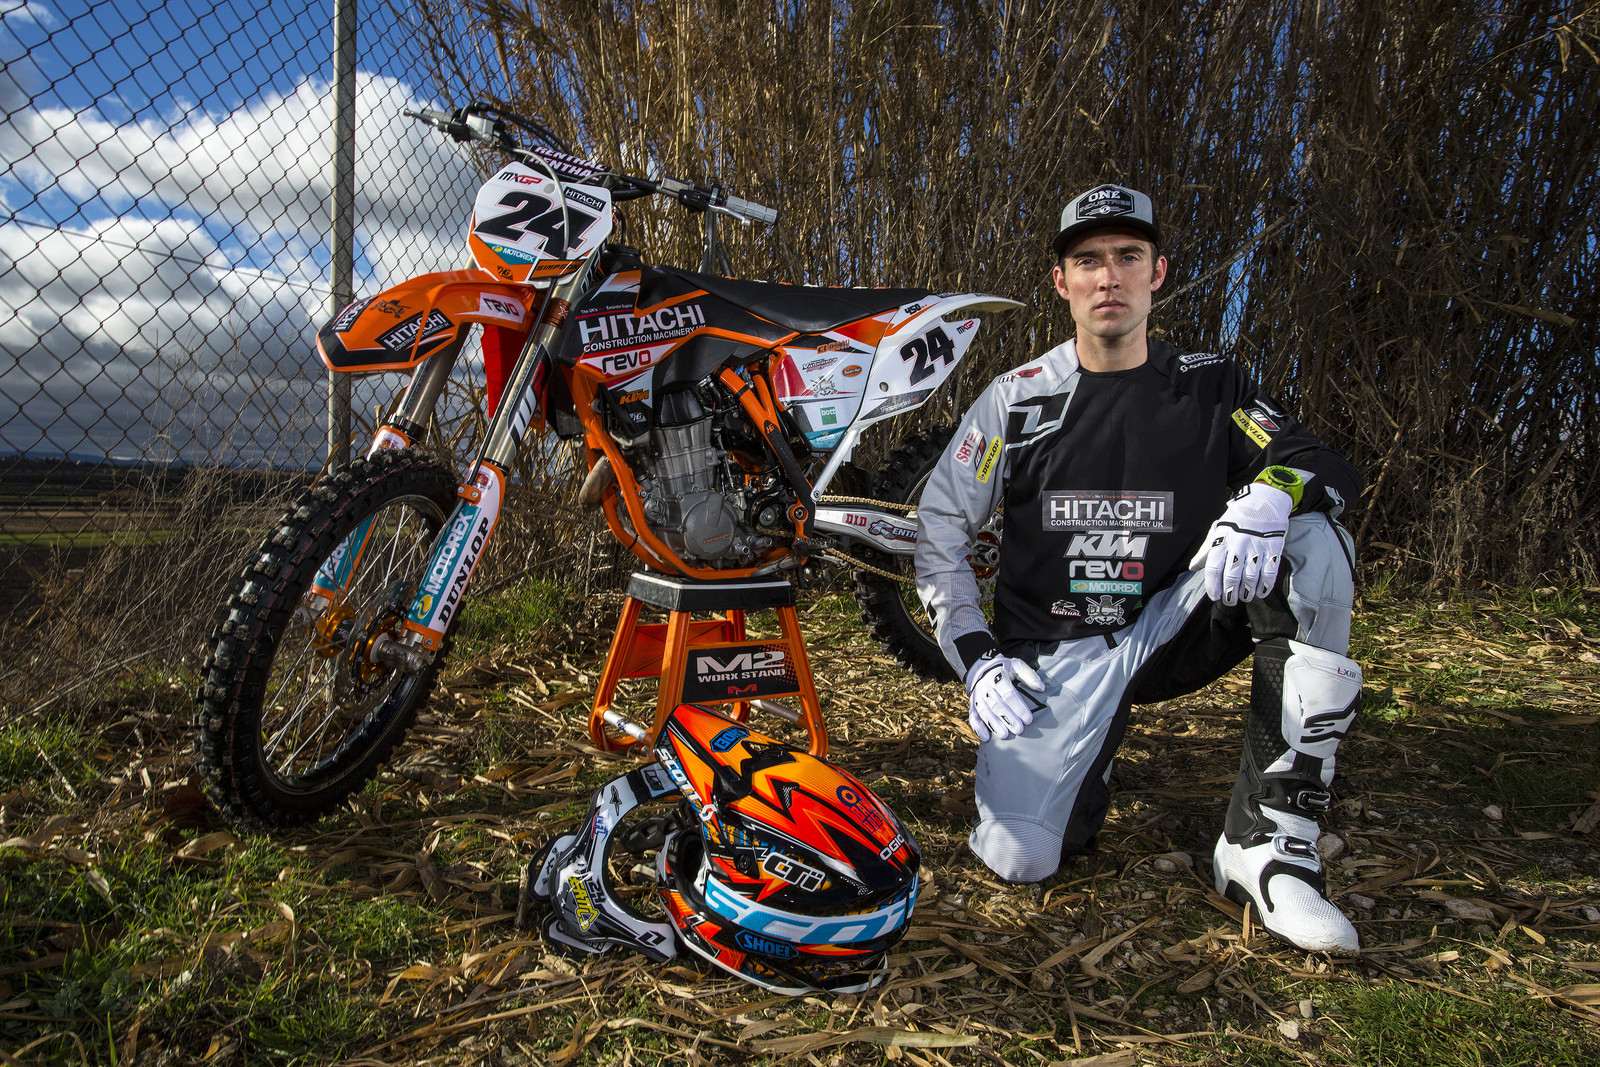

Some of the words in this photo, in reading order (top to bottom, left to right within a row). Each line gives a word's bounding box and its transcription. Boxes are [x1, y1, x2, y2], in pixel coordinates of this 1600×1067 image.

[534, 146, 607, 171] RENTHAL
[565, 188, 603, 208] HITACHI
[1088, 190, 1120, 202] ONE
[474, 190, 598, 258] 24
[502, 246, 535, 262] MOTOREX
[536, 262, 580, 271] SIMPSON
[904, 303, 922, 315] 450
[383, 313, 447, 349] HITACHI
[578, 304, 706, 344] HITACHI
[583, 334, 652, 353] CONSTRUCTION
[653, 327, 694, 341] MACHINERY
[602, 349, 651, 374] revo
[900, 325, 955, 387] 24
[619, 389, 649, 405] KTM
[821, 408, 836, 416] bott
[1239, 418, 1269, 444] DUNLOP
[982, 439, 999, 475] DUNLOP
[1050, 500, 1165, 520] HITACHI
[1051, 519, 1108, 527] CONSTRUCTION
[1109, 519, 1150, 527] MACHINERY
[424, 510, 474, 595] MOTOREX
[1065, 530, 1148, 558] KTM
[438, 516, 490, 628] DUNLOP
[1069, 560, 1144, 579] revo
[1088, 582, 1138, 593] MOTOREX
[1051, 609, 1081, 617] RENTHAL
[696, 651, 785, 675] M2
[741, 668, 786, 680] STAND
[657, 748, 702, 801] SCOTT
[743, 933, 790, 958] SHOEI
